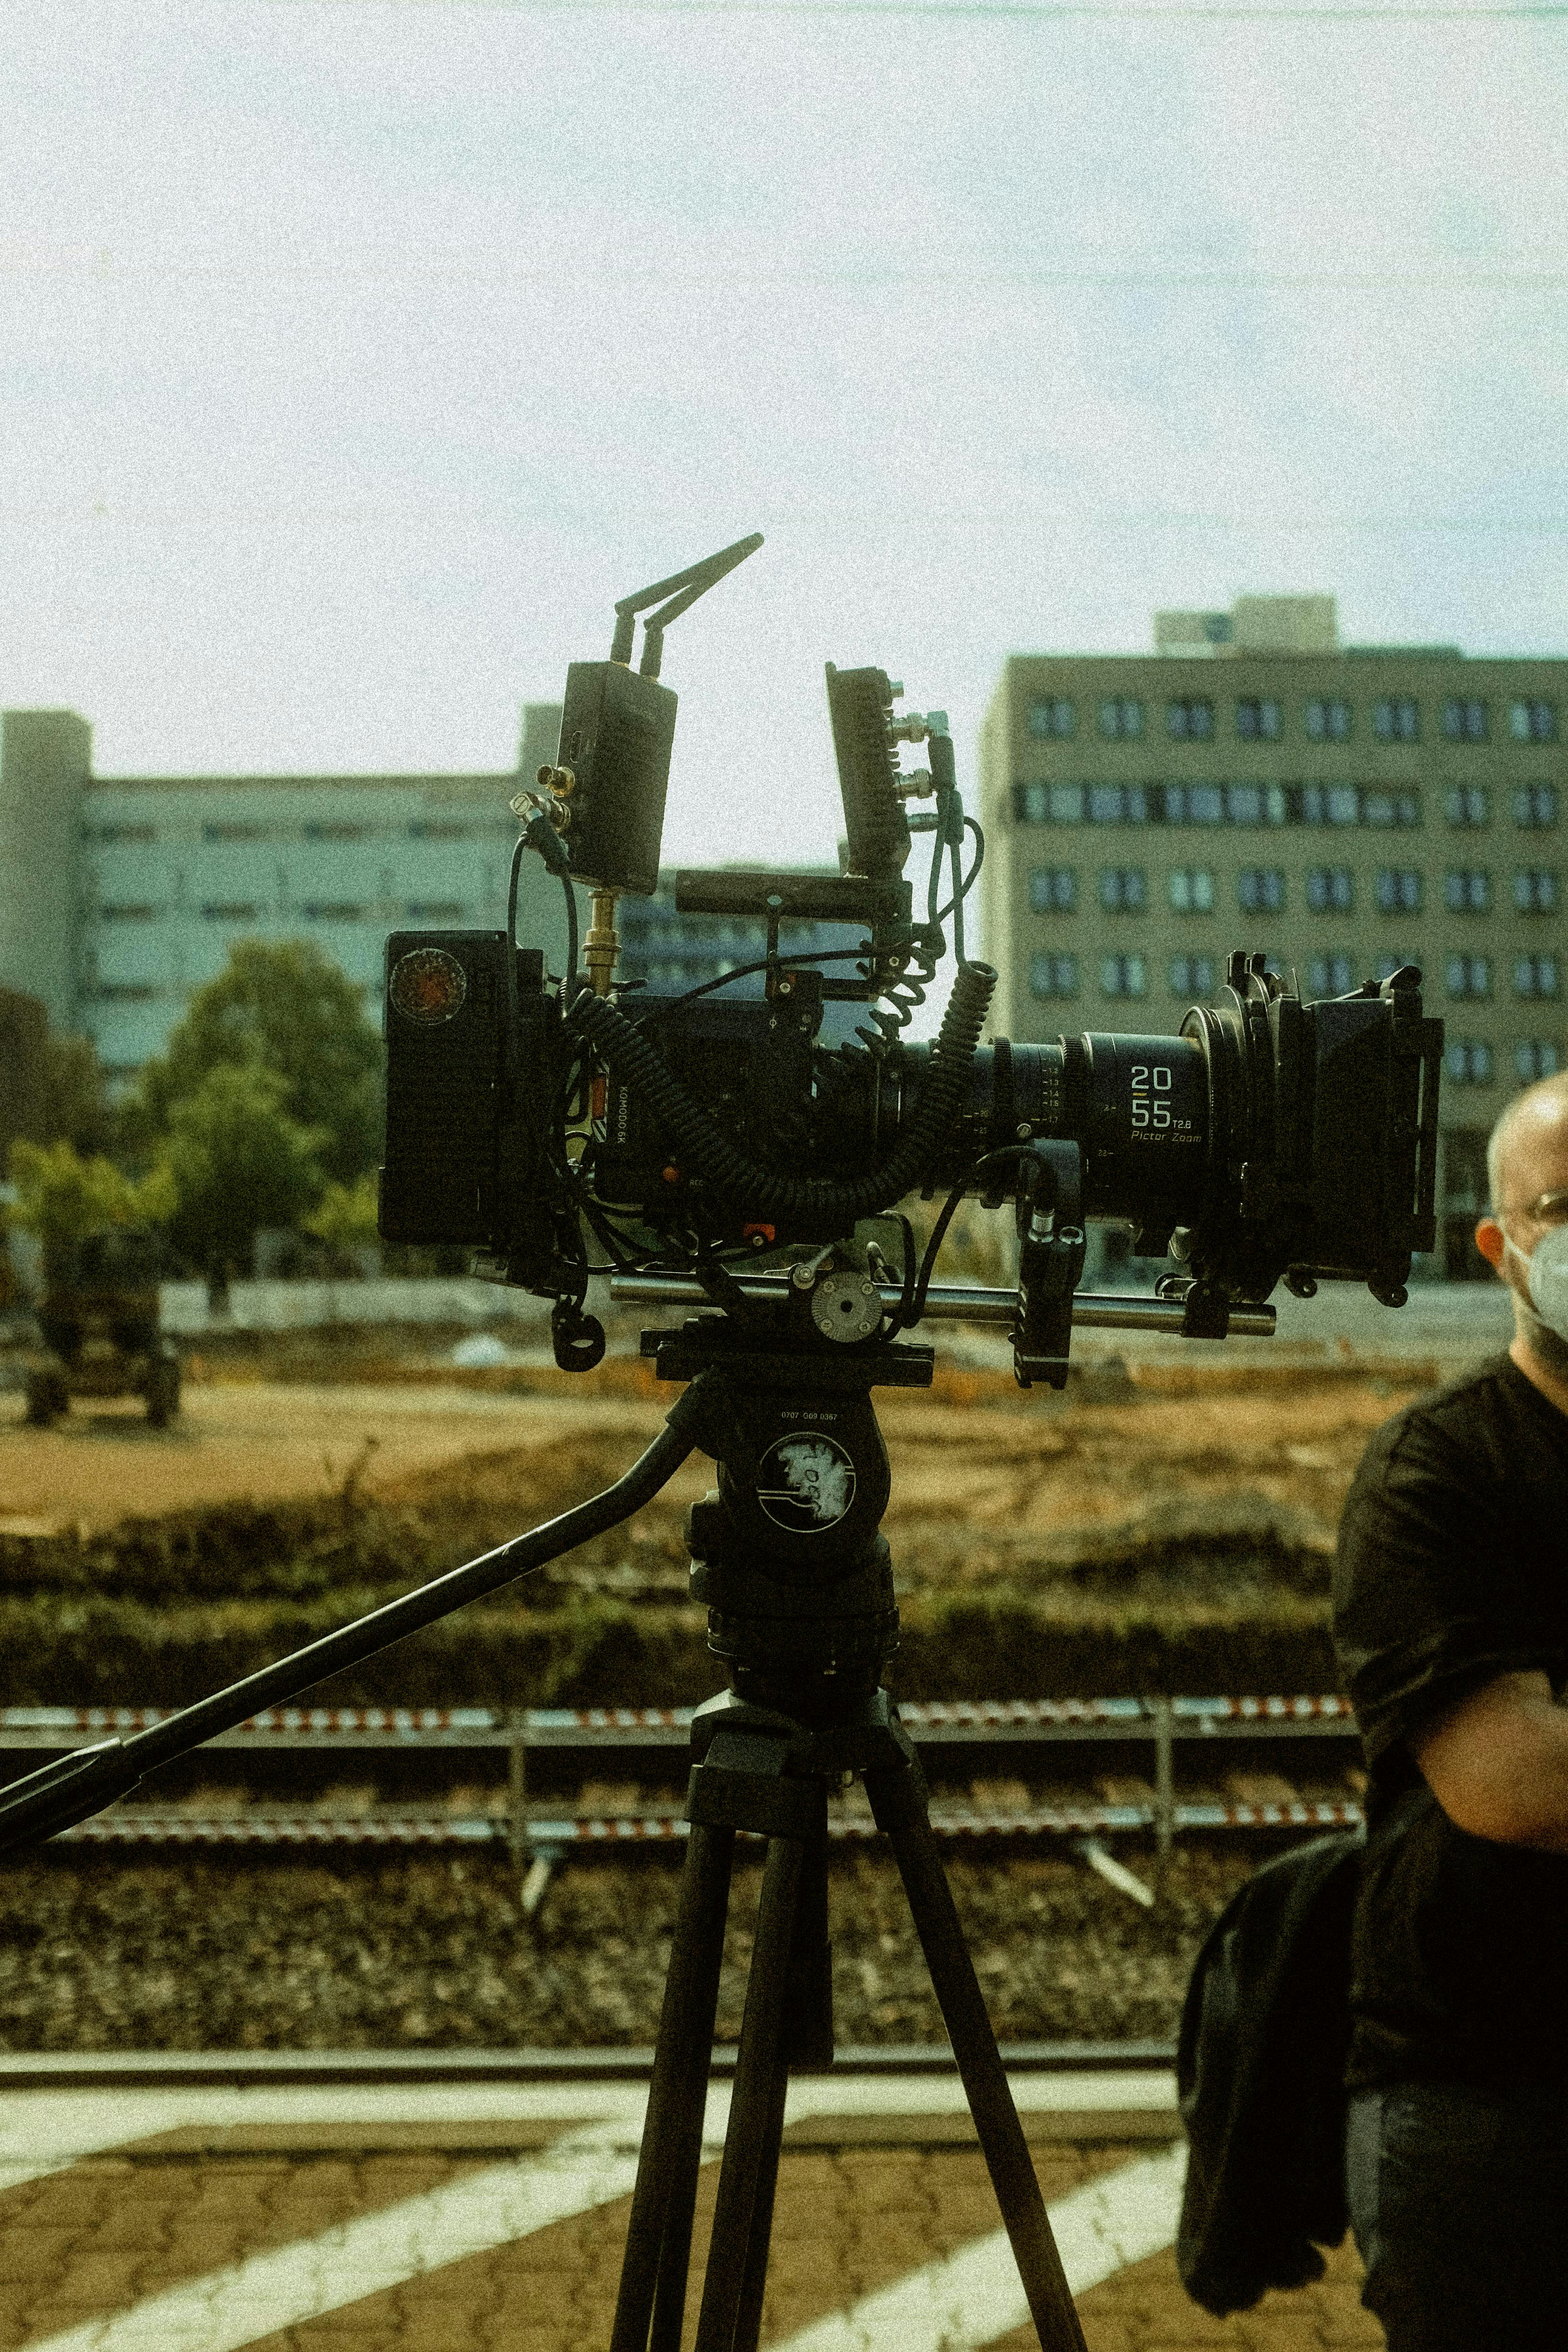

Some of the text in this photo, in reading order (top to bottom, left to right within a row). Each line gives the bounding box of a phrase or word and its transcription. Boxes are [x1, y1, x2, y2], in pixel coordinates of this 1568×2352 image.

[1131, 1066, 1172, 1090] 20
[617, 1086, 628, 1144] KOMODO 6K
[1131, 1099, 1191, 1129] 55 T2.8
[1131, 1130, 1202, 1143] Pictor Zoom
